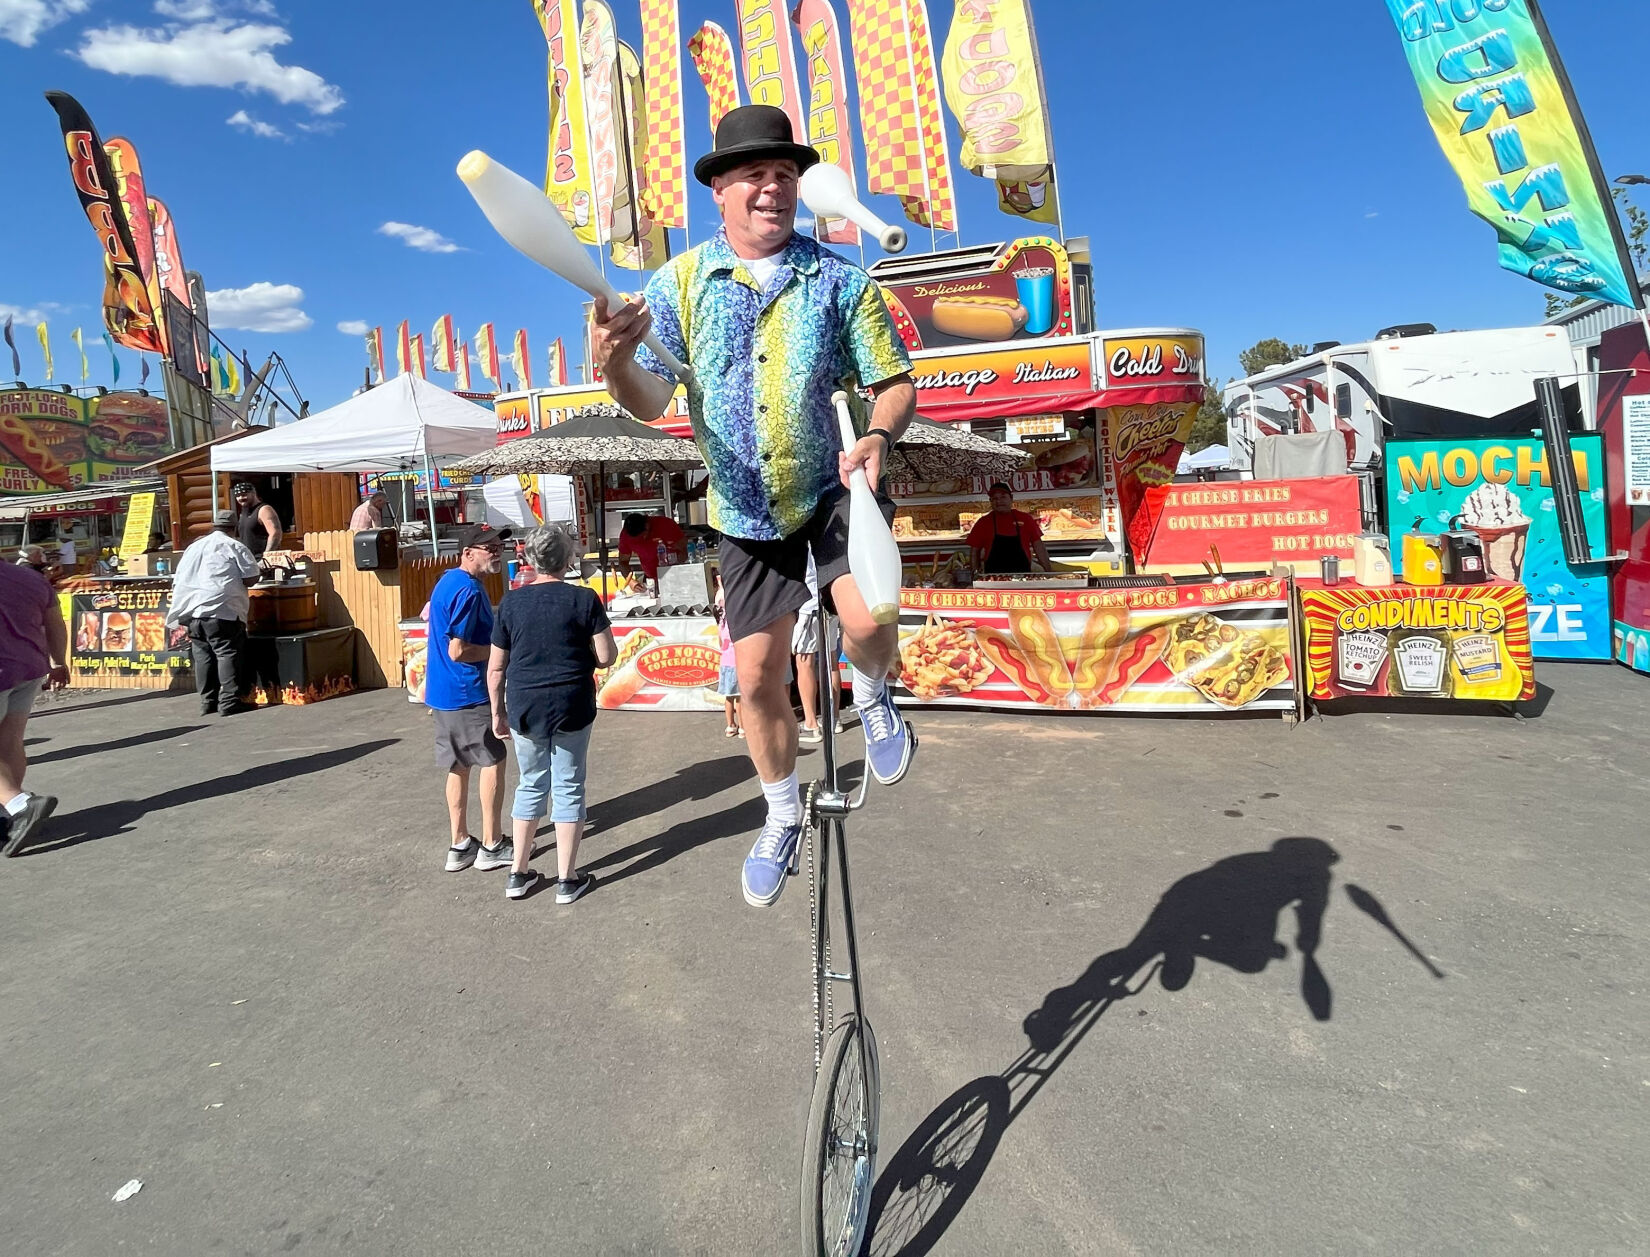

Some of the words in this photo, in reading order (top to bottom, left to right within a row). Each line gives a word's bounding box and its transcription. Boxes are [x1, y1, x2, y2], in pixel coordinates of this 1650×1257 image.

[1109, 345, 1163, 377] Cold
[1012, 360, 1079, 384] Italian
[0, 402, 33, 414] ORN
[39, 402, 78, 419] DOGS
[496, 406, 528, 434] rinks
[5, 468, 37, 479] FRES
[972, 470, 1055, 494] BUGER
[0, 478, 39, 491] URLY
[1181, 489, 1239, 506] CHEESE
[1242, 486, 1291, 502] FRIES
[56, 499, 96, 512] DOGS
[1103, 487, 1117, 533] WATER
[1167, 513, 1248, 530] GOURMET
[1252, 509, 1329, 527] BURGERS
[1271, 535, 1310, 551] HOT
[1313, 533, 1356, 549] DOGS
[931, 591, 996, 608] CHEESE
[1000, 591, 1056, 608] FRIES
[1077, 591, 1127, 608] CORN
[1131, 589, 1179, 606] DOGS
[1202, 581, 1281, 602] NACHOS
[118, 593, 162, 609] SLOW
[1338, 597, 1503, 631] CONDIMENTS
[1351, 635, 1379, 645] HEINZ
[1407, 642, 1433, 650] HEINZ
[1461, 639, 1484, 648] HEINZ
[642, 649, 668, 665] TOP
[1345, 643, 1380, 656] TOMATO
[1345, 651, 1378, 660] KETCHUP
[1459, 647, 1493, 657] MUSTARD
